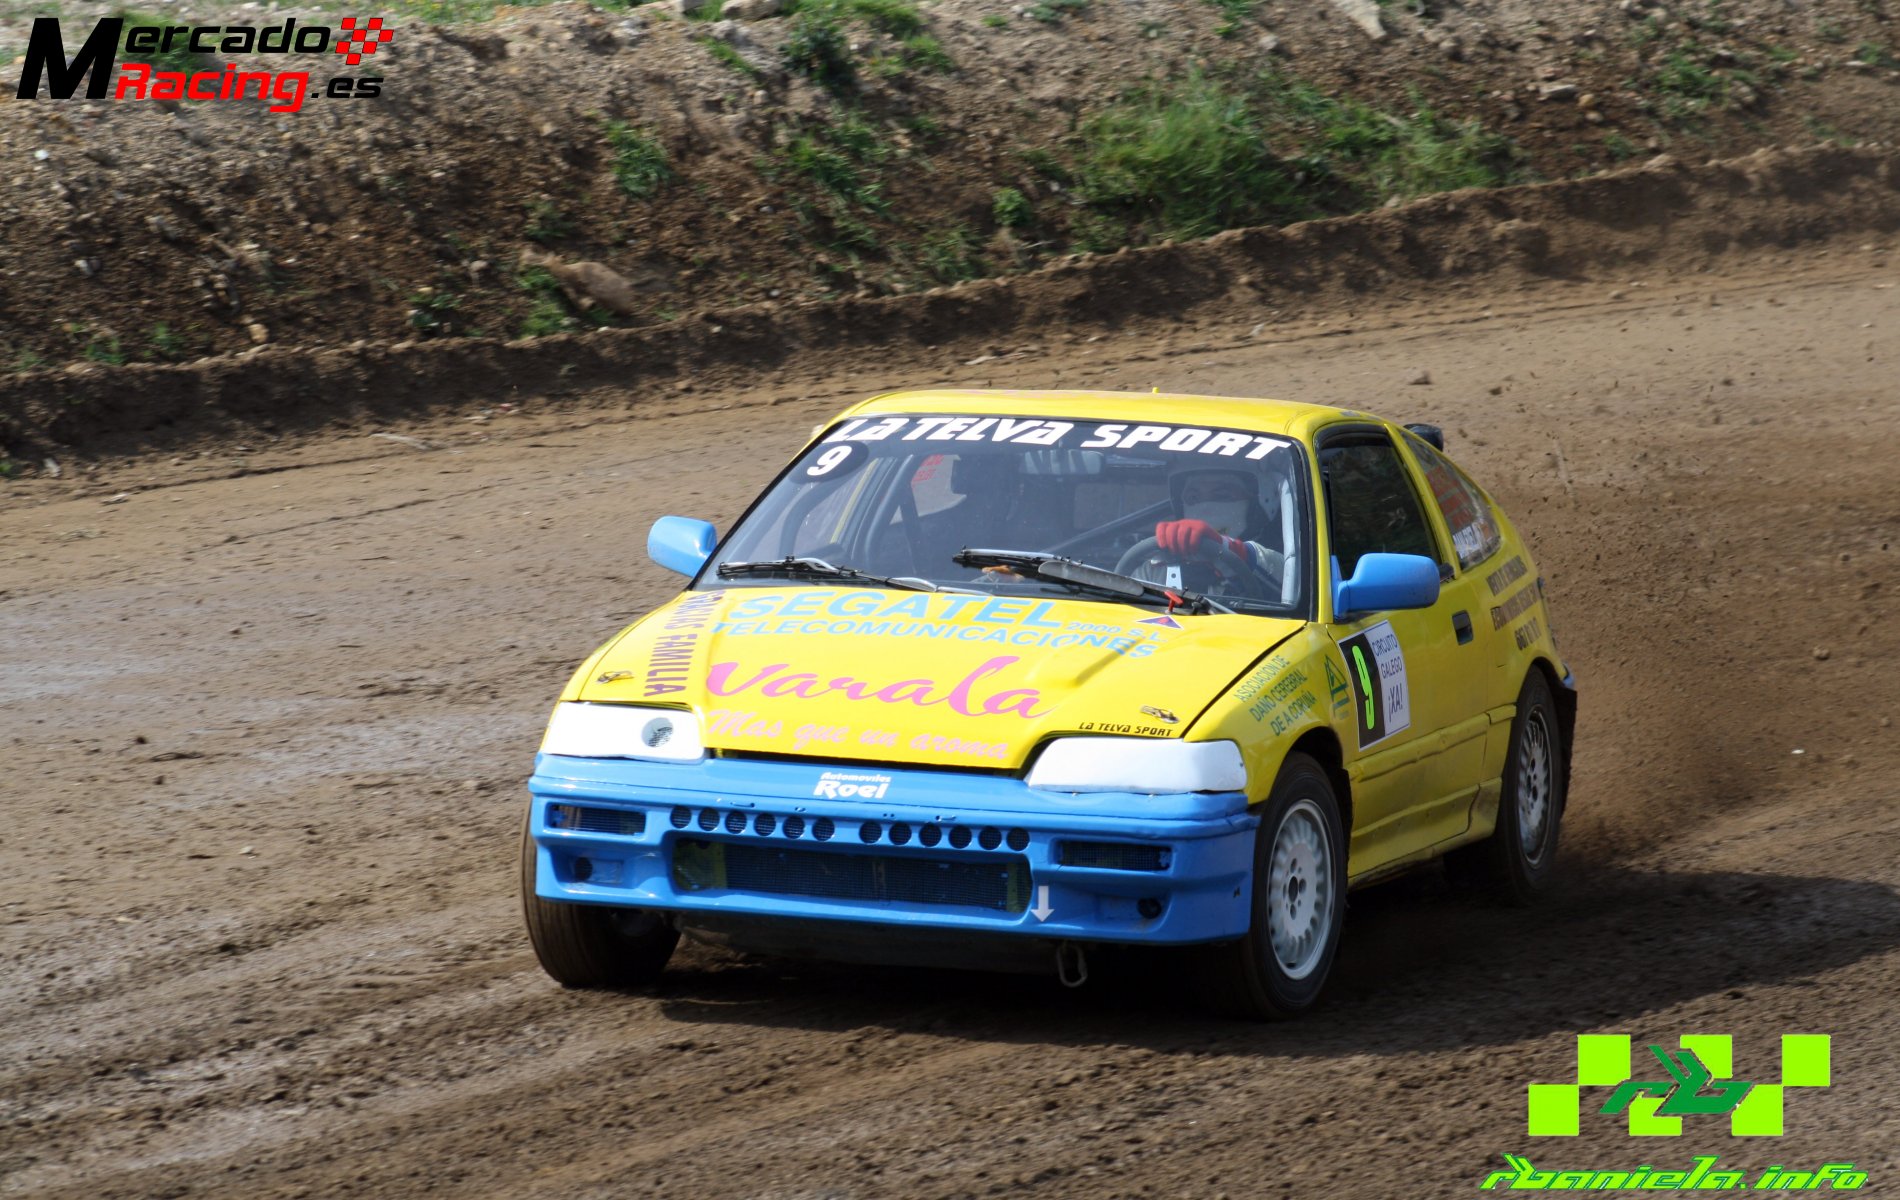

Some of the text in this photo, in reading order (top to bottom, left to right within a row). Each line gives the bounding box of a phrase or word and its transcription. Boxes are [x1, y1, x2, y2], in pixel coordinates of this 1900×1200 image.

[1080, 424, 1292, 460] SPORT
[806, 445, 853, 476] 9
[729, 591, 1063, 628] SEGATEL
[1066, 621, 1122, 634] 2000
[710, 619, 1159, 658] TELECOMUNICACIONES
[1372, 633, 1398, 657] CIRCUITO
[643, 634, 698, 697] FAMILIA
[1381, 656, 1403, 680] GALEGO
[706, 656, 1058, 719] Varala
[1271, 668, 1308, 702] CEREBRAL
[1351, 645, 1375, 730] 9
[708, 709, 1009, 760] Mas que un aroma
[1134, 725, 1174, 737] SPORT
[1270, 716, 1287, 737] DE
[1283, 711, 1294, 727] A
[813, 780, 890, 799] Roel
